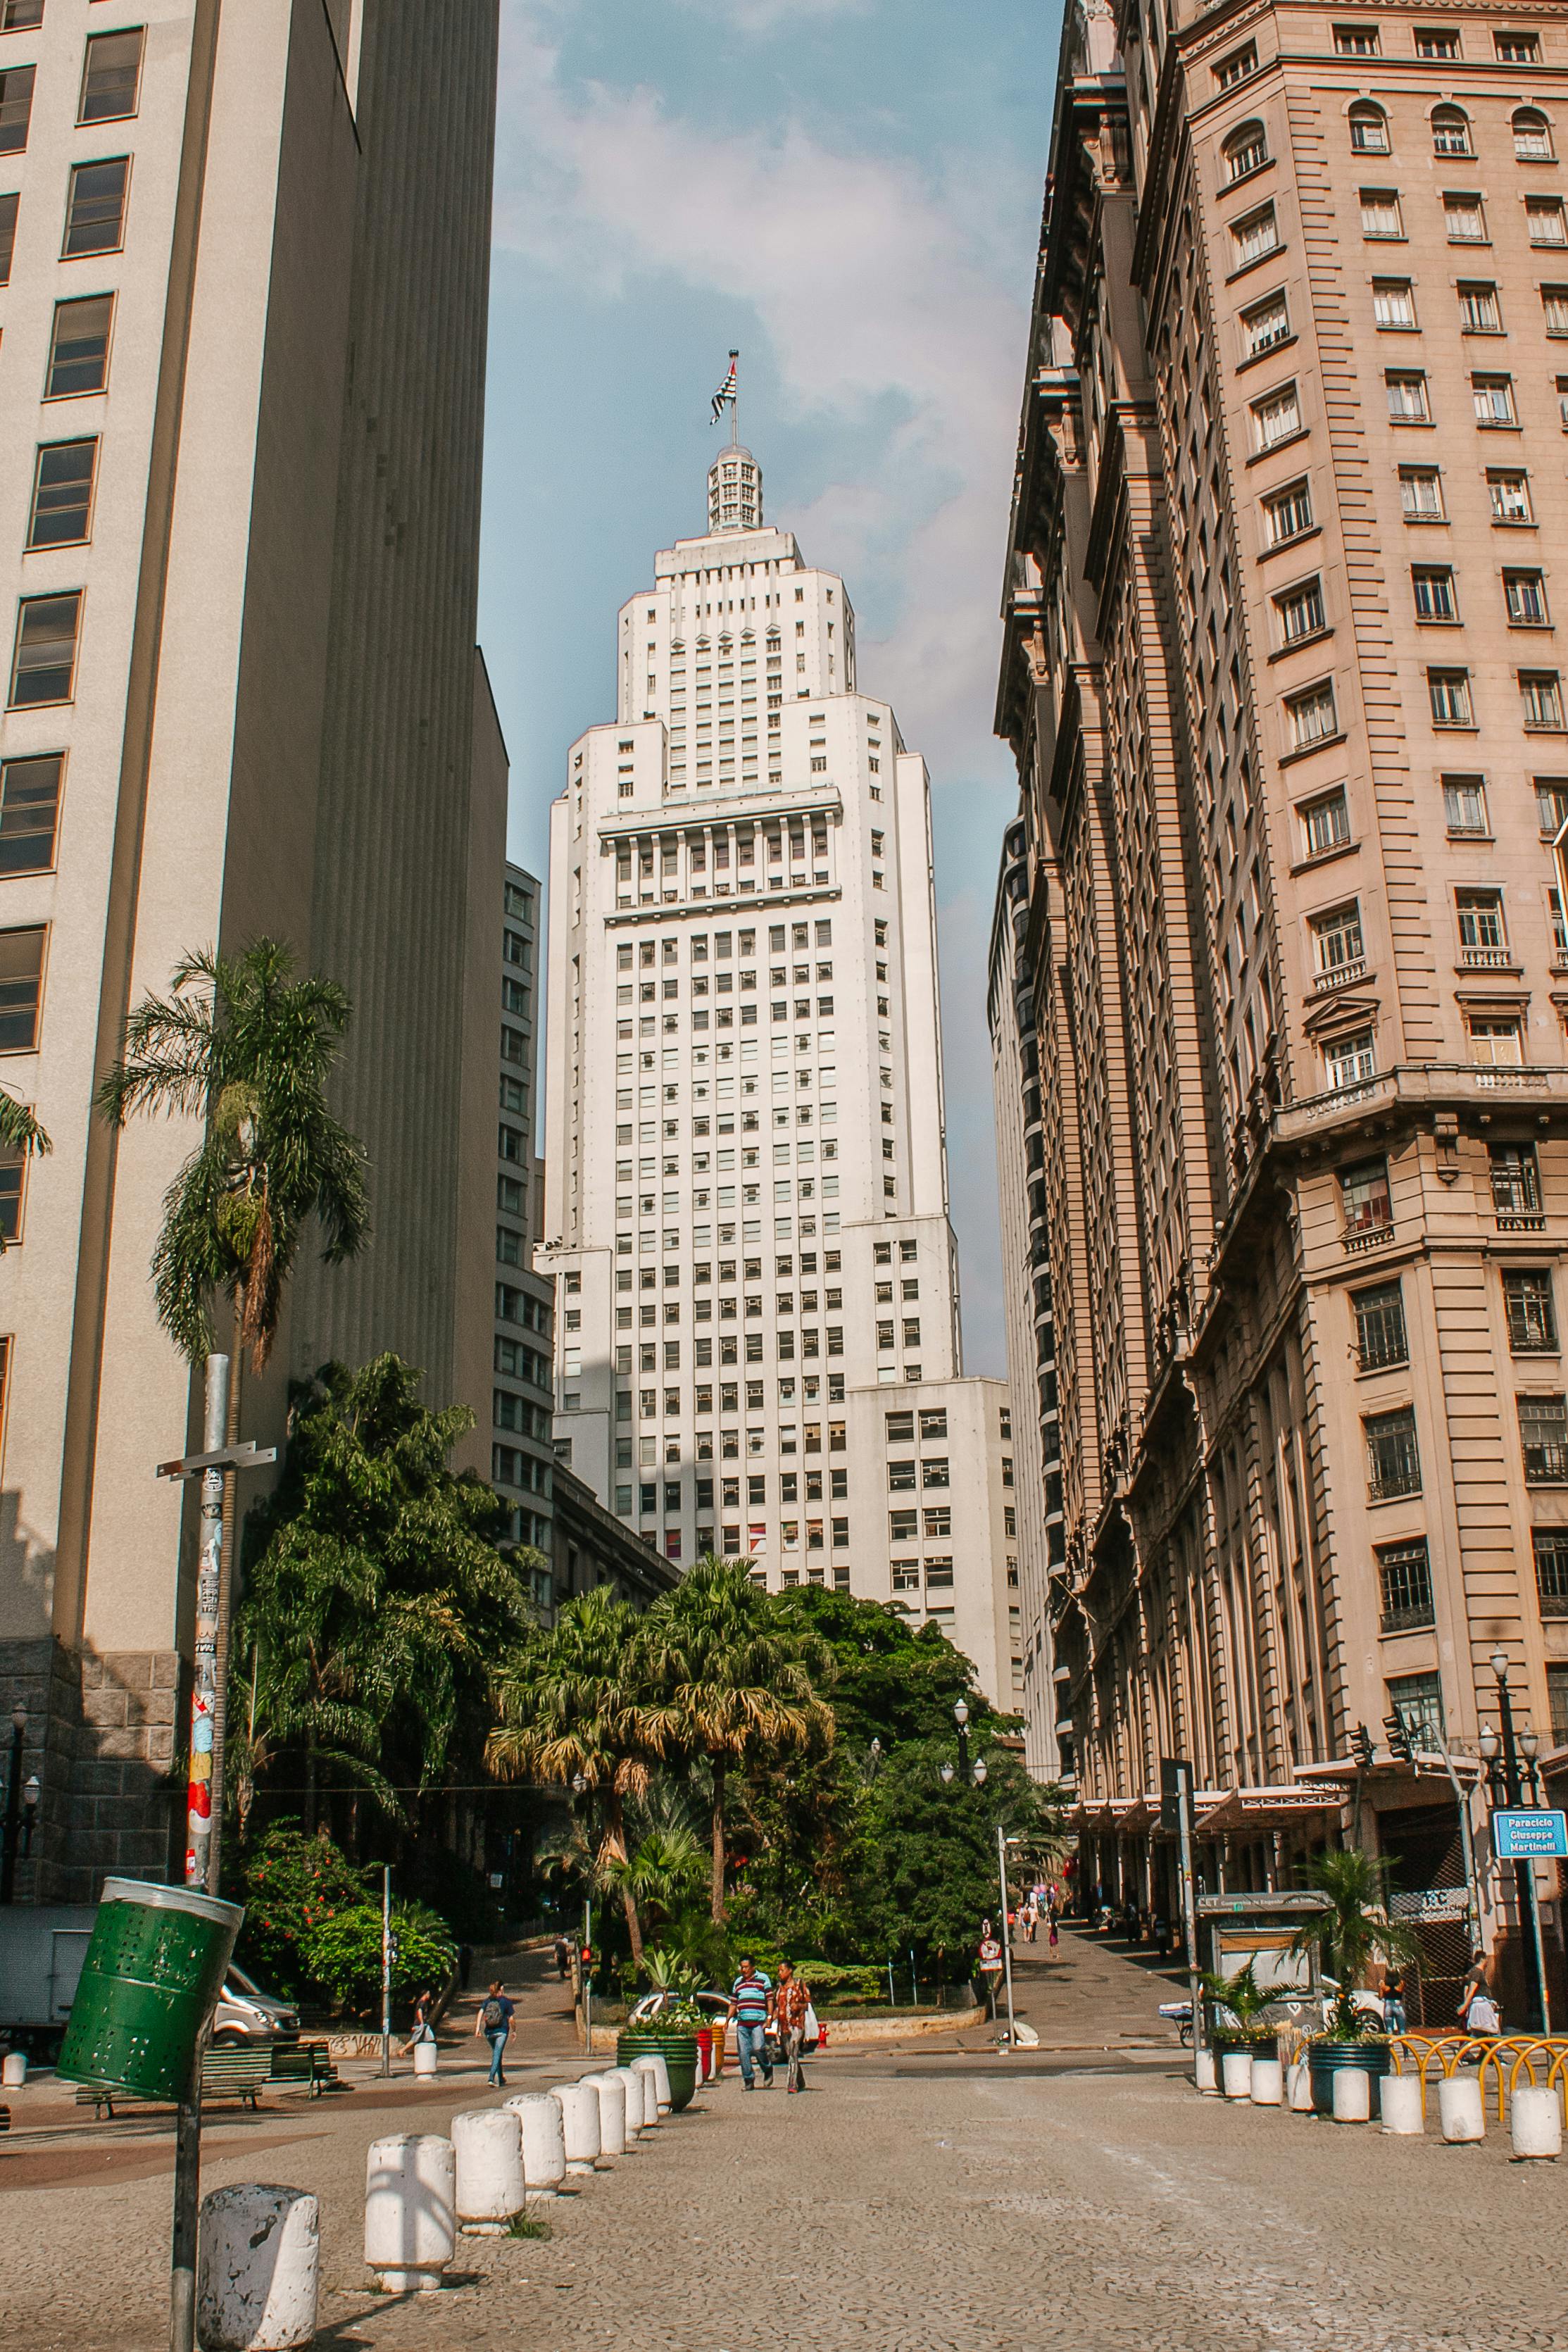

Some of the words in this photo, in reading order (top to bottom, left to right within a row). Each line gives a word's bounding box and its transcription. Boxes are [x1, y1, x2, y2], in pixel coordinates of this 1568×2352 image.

[1508, 1818, 1553, 1827] Paraciclo
[1510, 1830, 1553, 1840] Giuseppe
[1510, 1842, 1556, 1852] Martinelli
